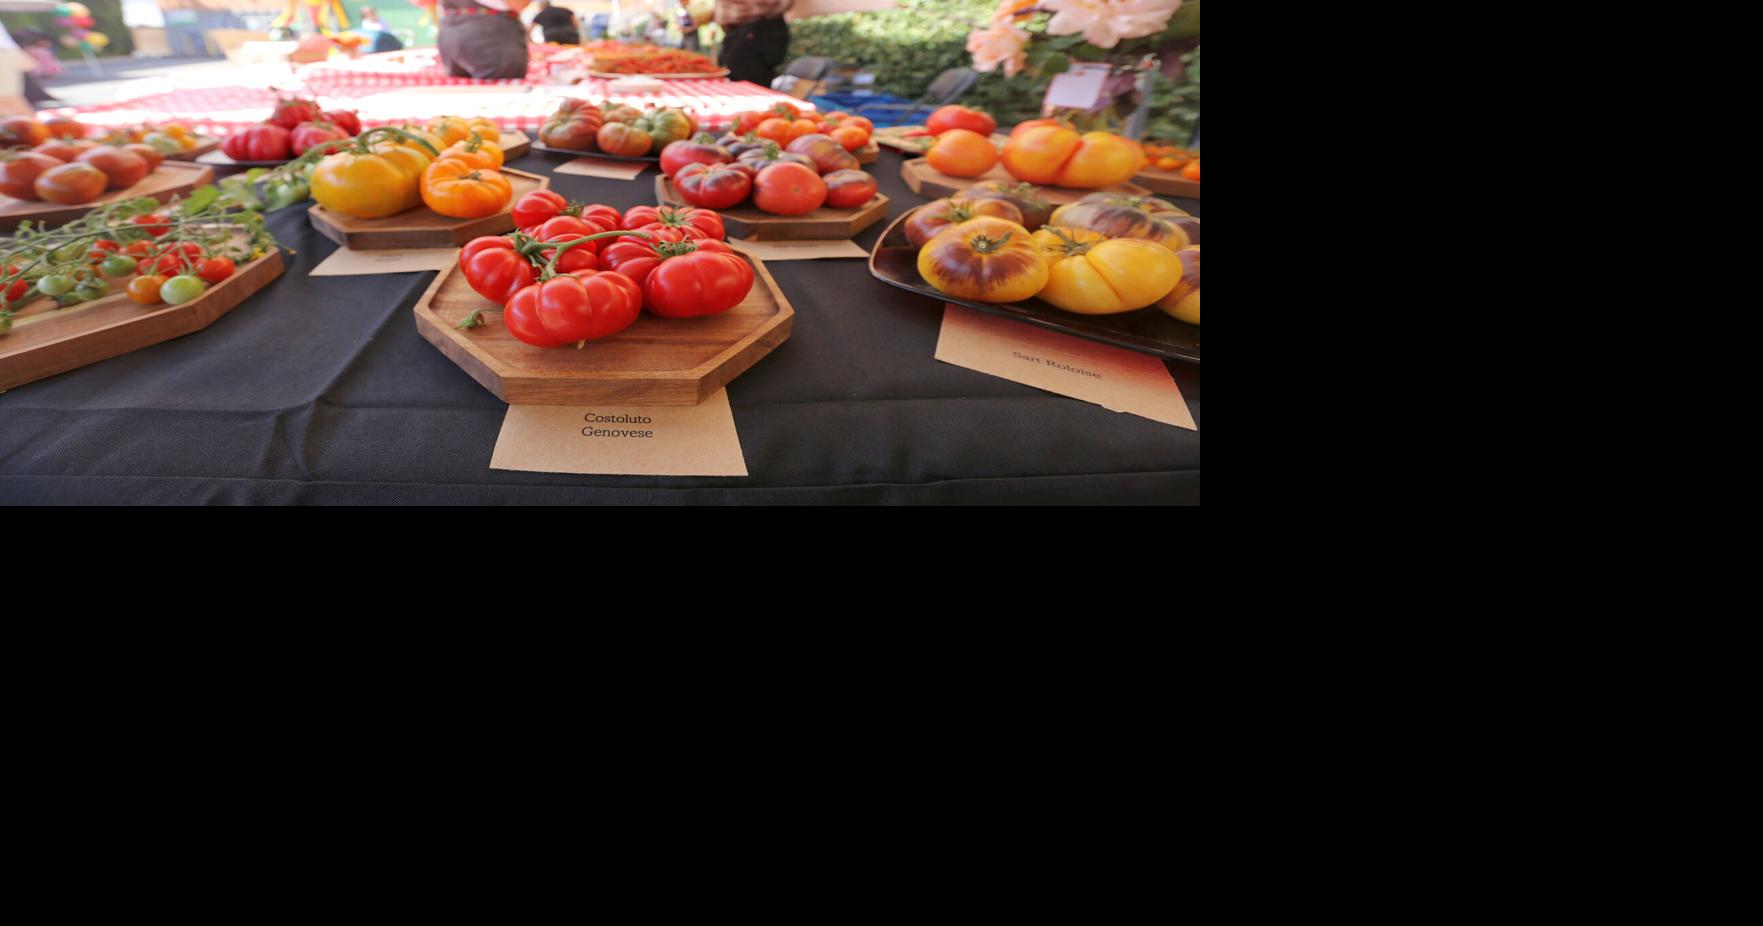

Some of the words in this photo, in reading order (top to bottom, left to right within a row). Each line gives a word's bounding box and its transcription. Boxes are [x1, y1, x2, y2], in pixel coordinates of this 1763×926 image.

[1012, 351, 1041, 364] Sart
[1046, 359, 1102, 379] Roloise
[584, 412, 652, 424] Costoluto
[582, 426, 653, 438] Genovese
